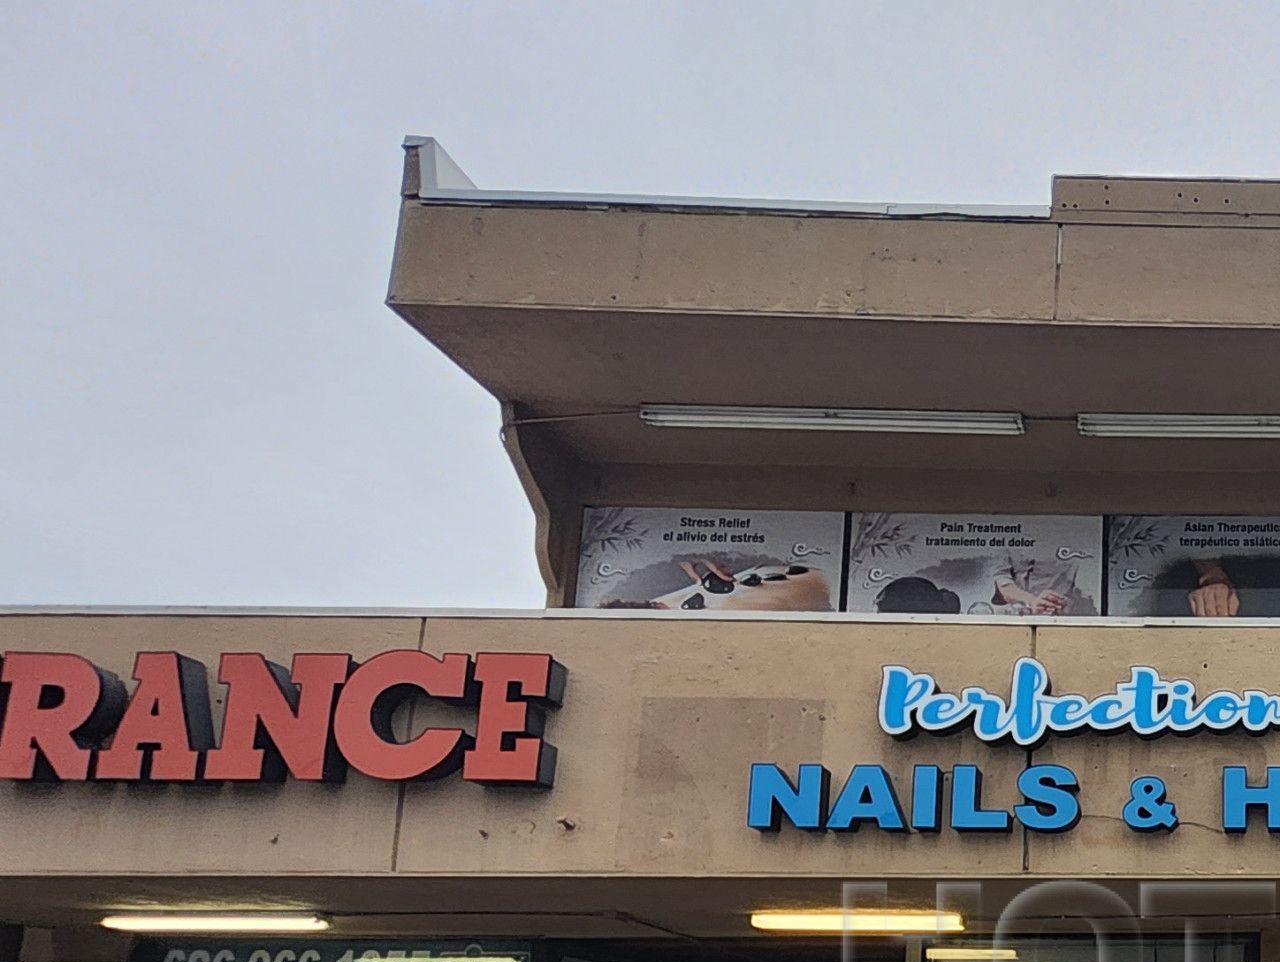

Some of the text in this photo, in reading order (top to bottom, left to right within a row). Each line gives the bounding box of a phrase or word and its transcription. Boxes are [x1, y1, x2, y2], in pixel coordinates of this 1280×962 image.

[680, 517, 750, 528] Stress Relief
[940, 523, 1021, 534] Pain Treatment
[1184, 522, 1280, 535] Asian Therapeutic
[663, 531, 765, 543] el alivio del estrés
[926, 536, 1036, 548] tratamiento del dolor
[0, 650, 552, 781] RANCE
[747, 763, 1081, 832] NAILS
[1122, 775, 1179, 831] &
